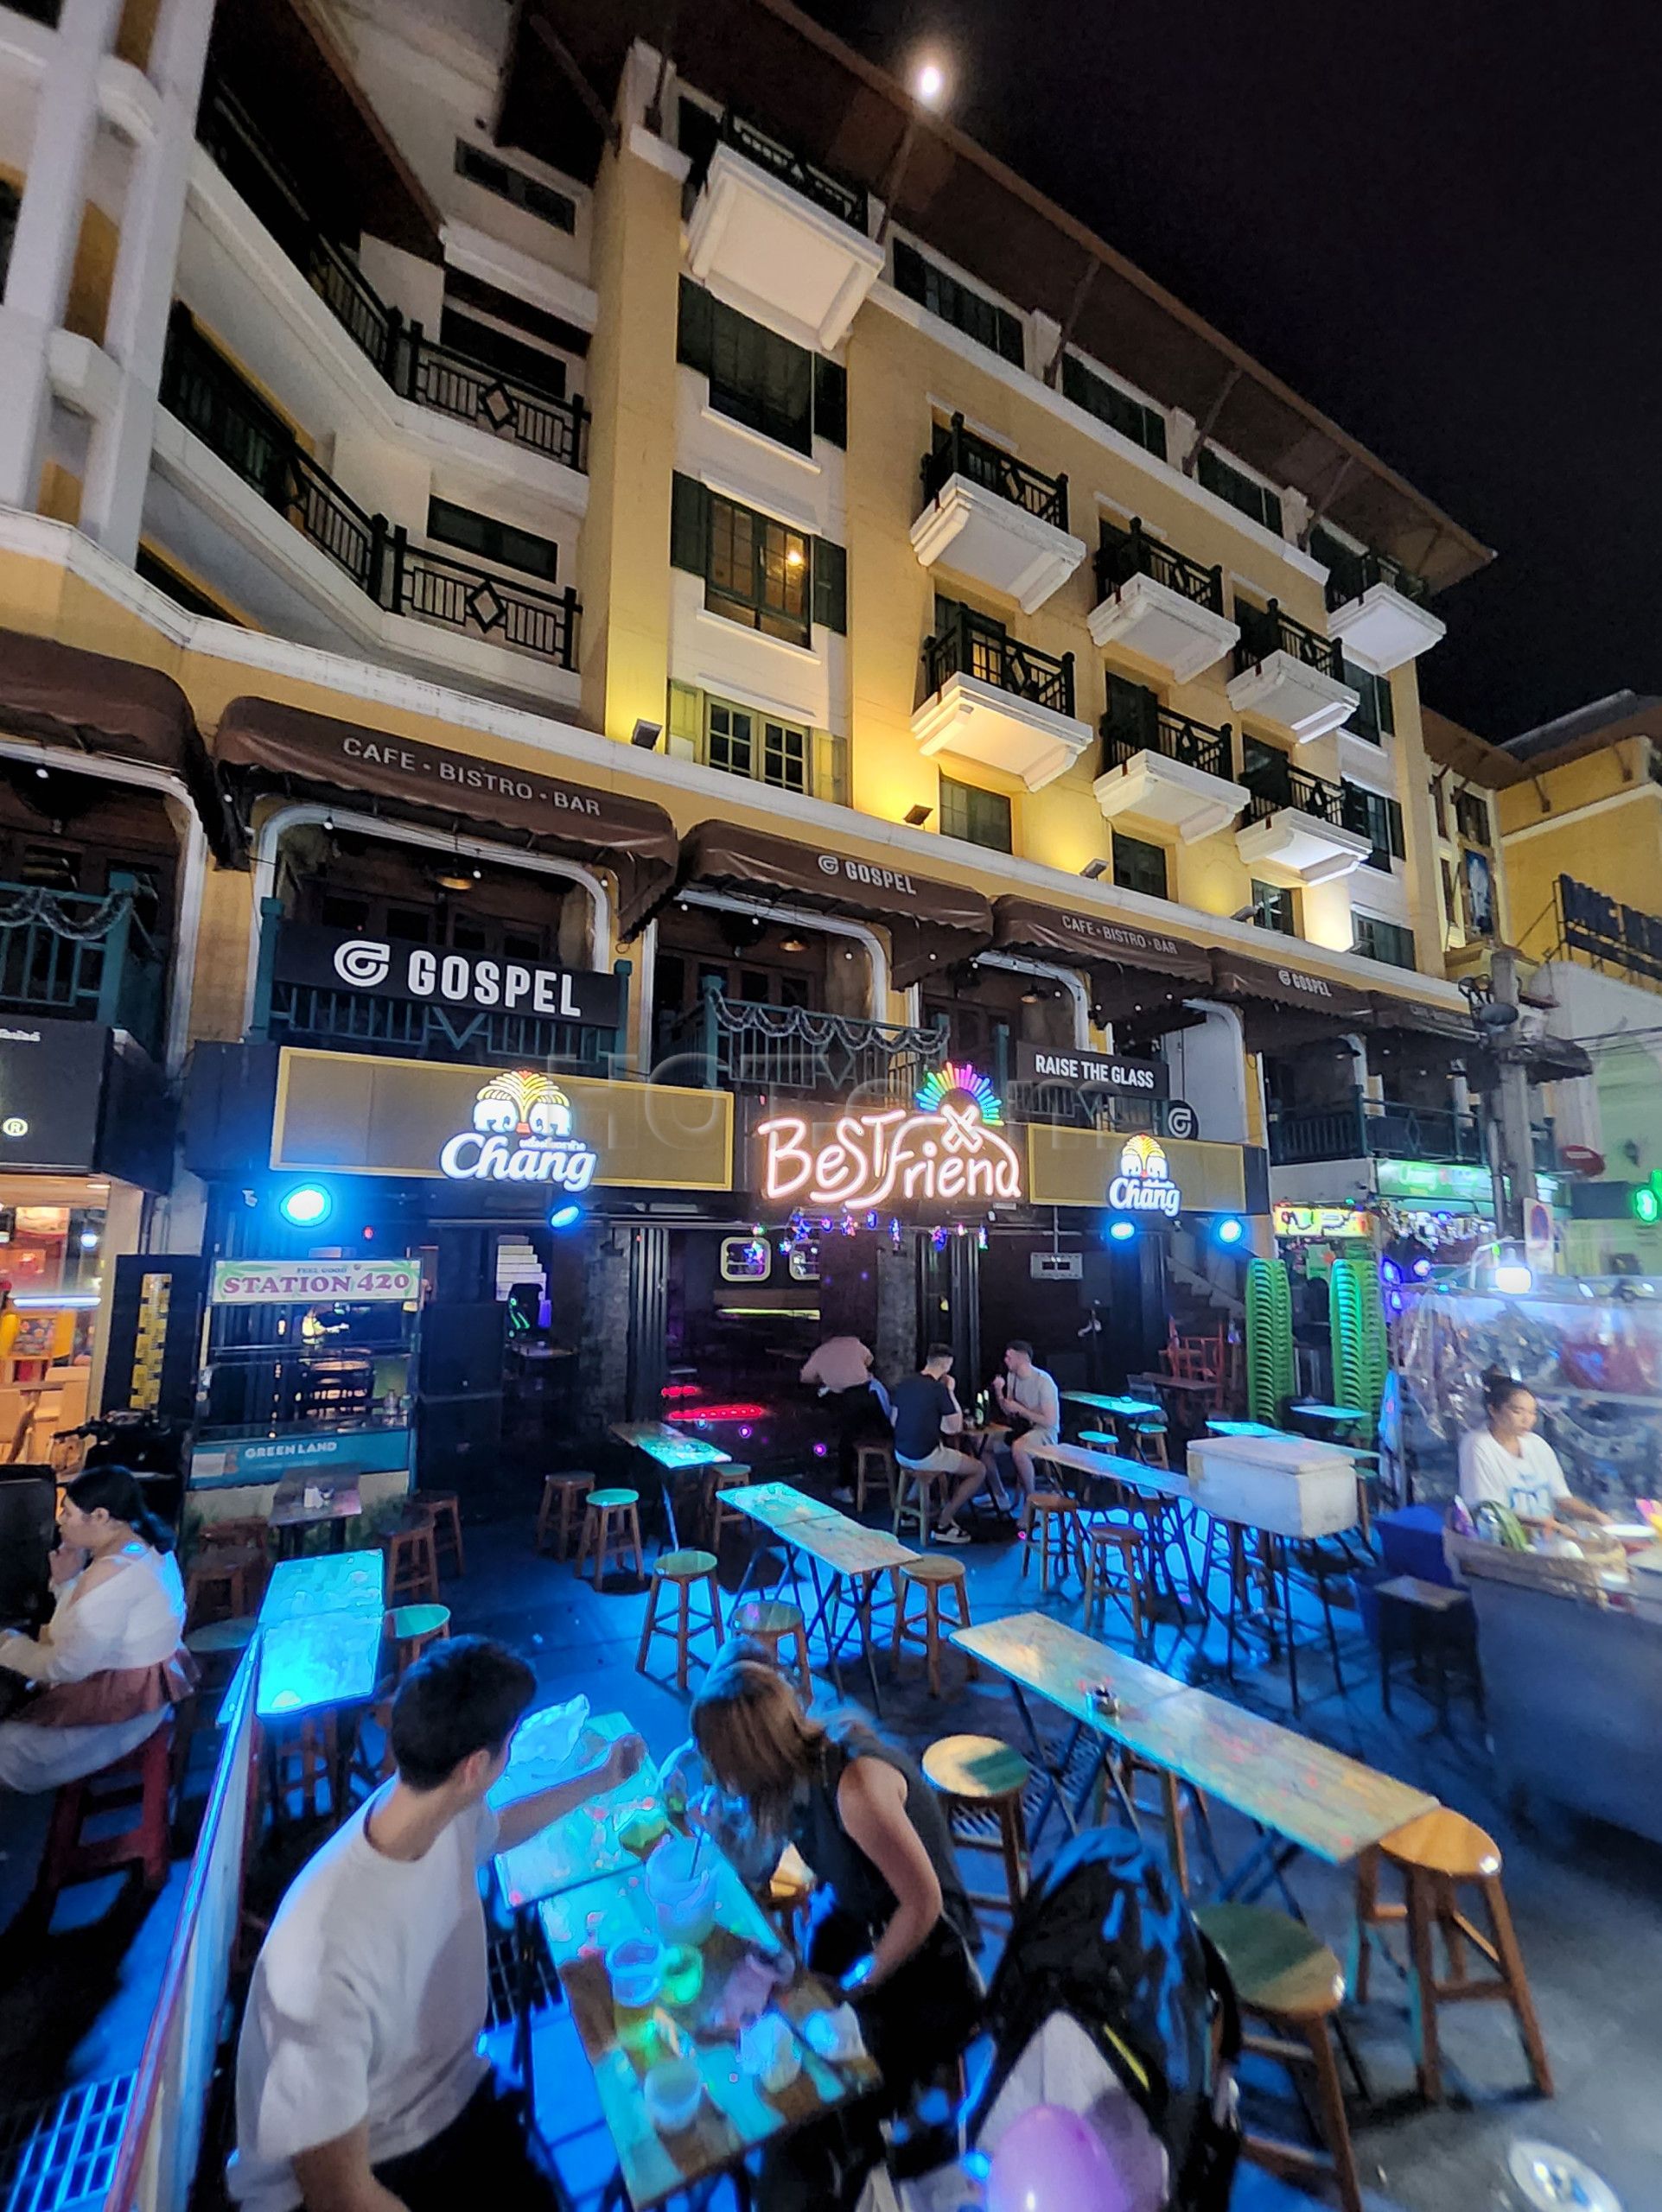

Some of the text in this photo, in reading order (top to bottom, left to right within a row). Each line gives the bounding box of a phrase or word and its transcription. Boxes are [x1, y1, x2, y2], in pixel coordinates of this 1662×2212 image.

[342, 737, 602, 817] CAFE BISTRO BAR
[844, 860, 917, 895] GOSPEL
[1061, 915, 1178, 955] CAFE BISTRO BAR
[407, 950, 582, 1018] GOSPEL
[1291, 972, 1332, 997] GOSPEL
[1035, 1054, 1155, 1090] RAISE THE GLASS
[441, 1131, 597, 1193] Chang
[1109, 1177, 1181, 1217] Chang
[222, 1272, 411, 1294] STATION 420
[245, 1441, 338, 1459] GREEN LAND
